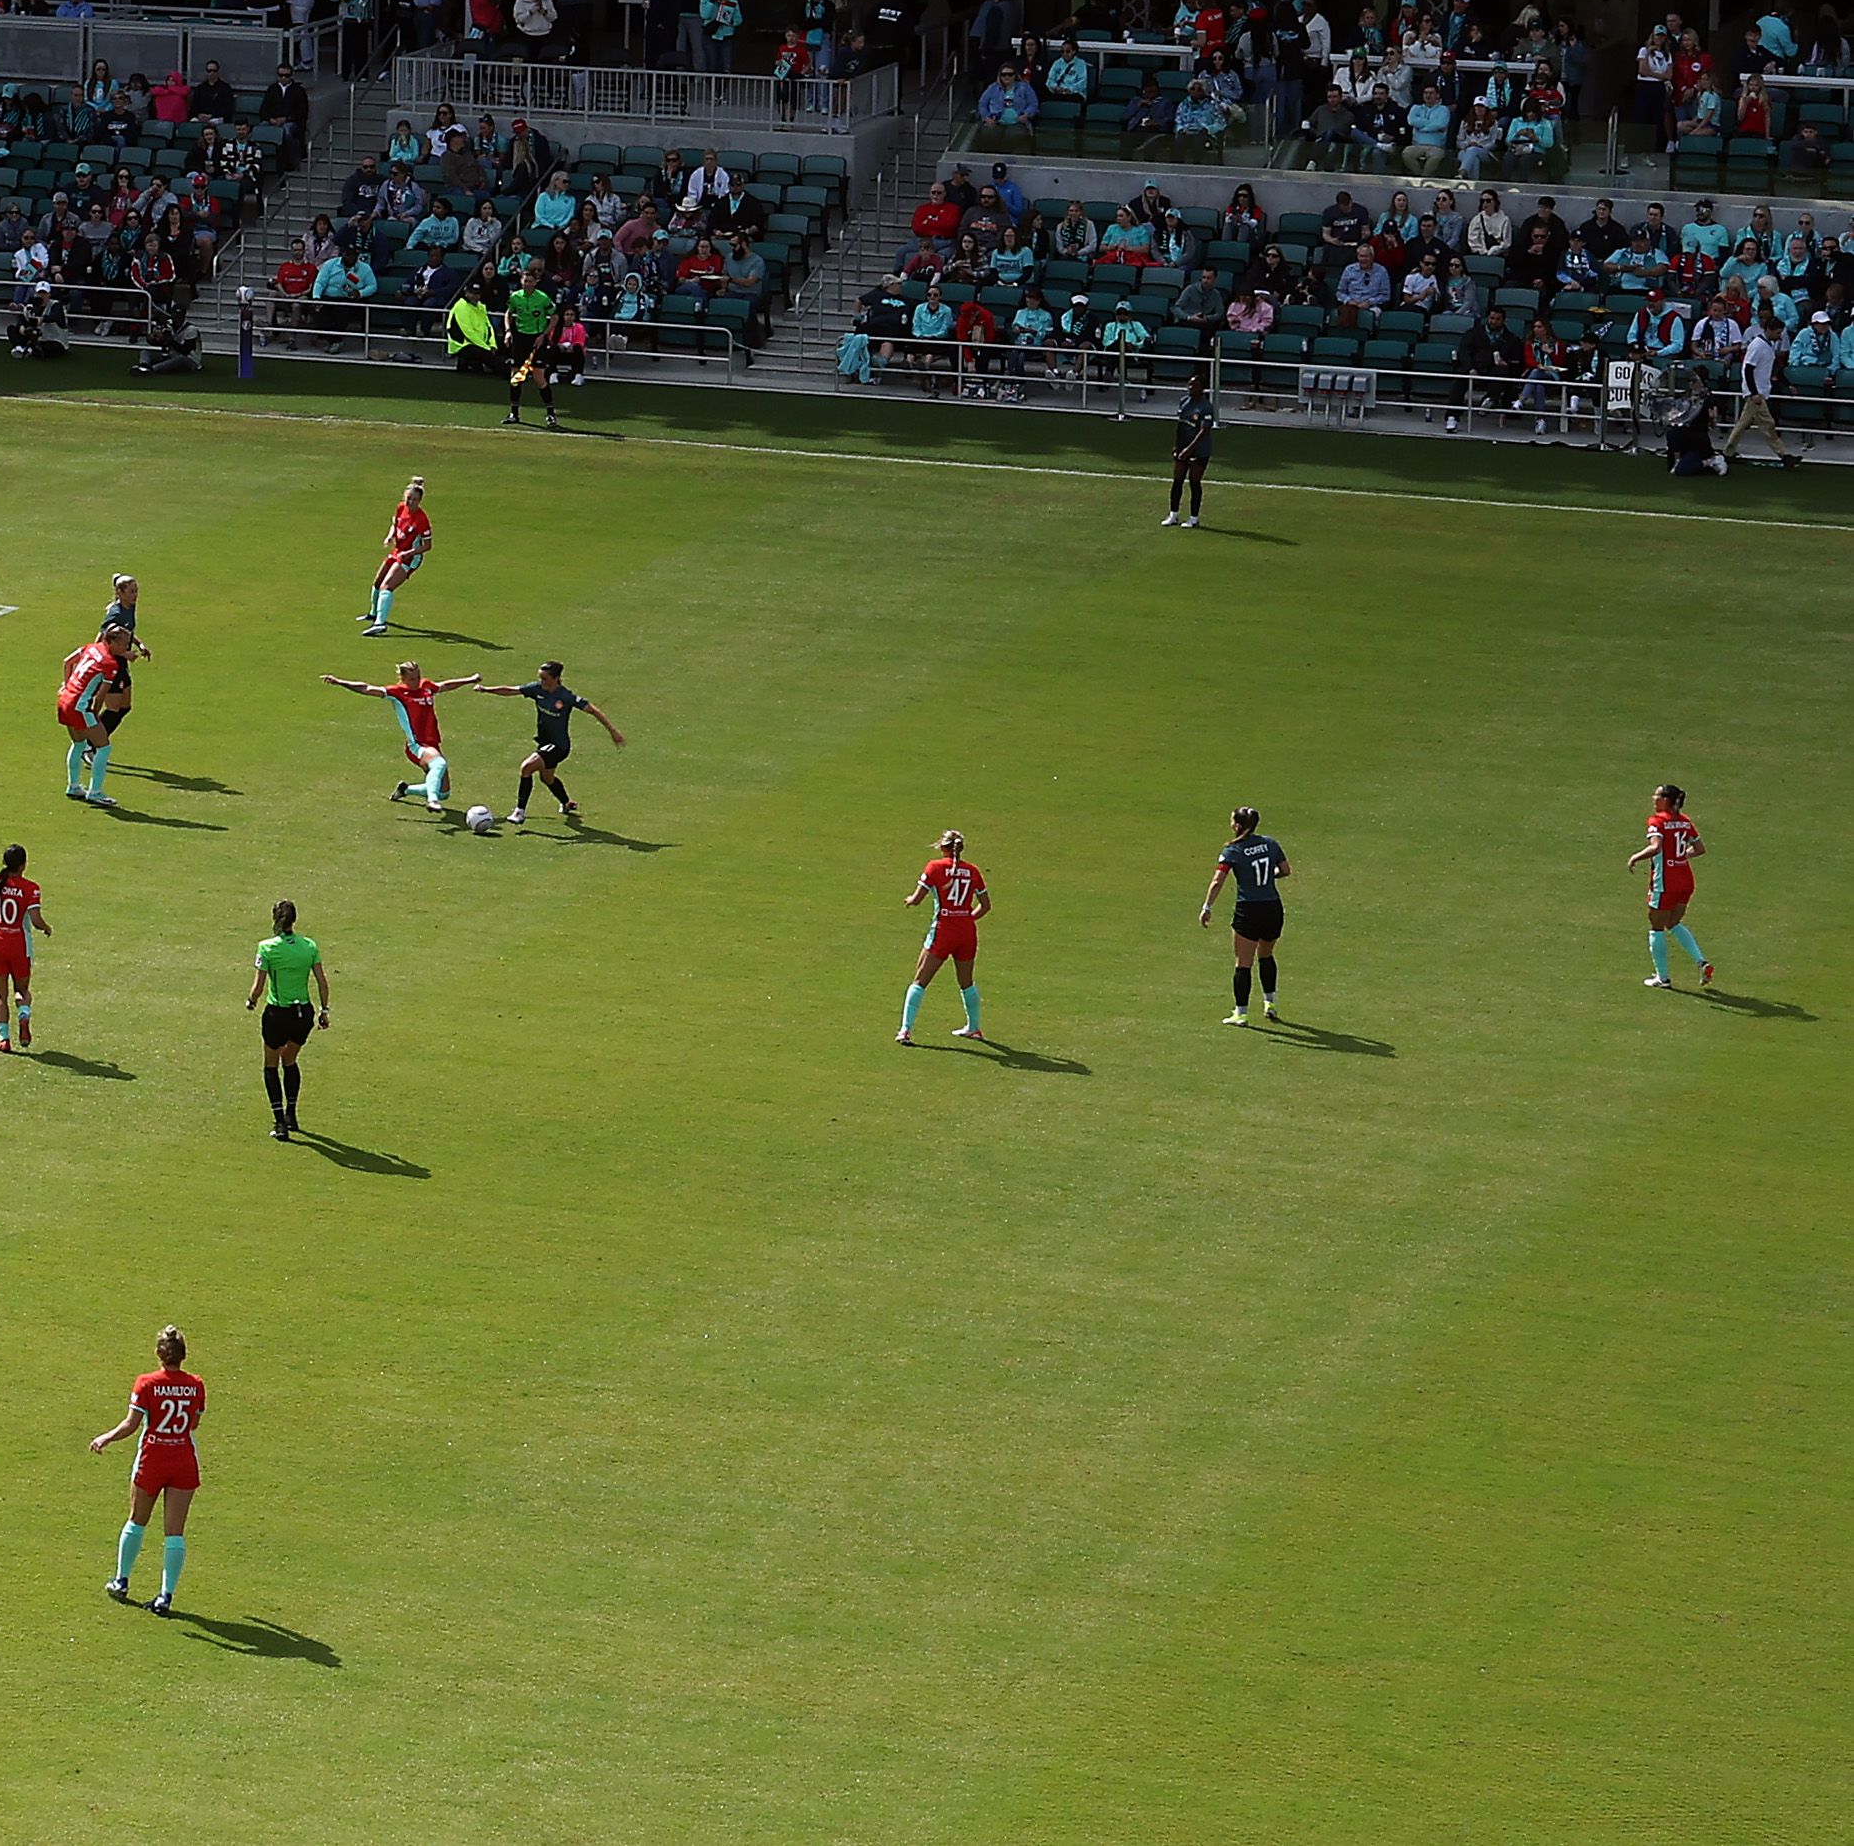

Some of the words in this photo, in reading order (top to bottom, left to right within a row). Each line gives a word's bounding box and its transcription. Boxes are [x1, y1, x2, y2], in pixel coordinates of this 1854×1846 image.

[1615, 366, 1631, 379] GO
[1244, 844, 1269, 857] COFFEY
[1674, 832, 1687, 857] 16
[1251, 857, 1270, 887] 17
[946, 879, 972, 907] 47
[154, 1385, 197, 1398] HAMILTON
[156, 1399, 191, 1435] 25
